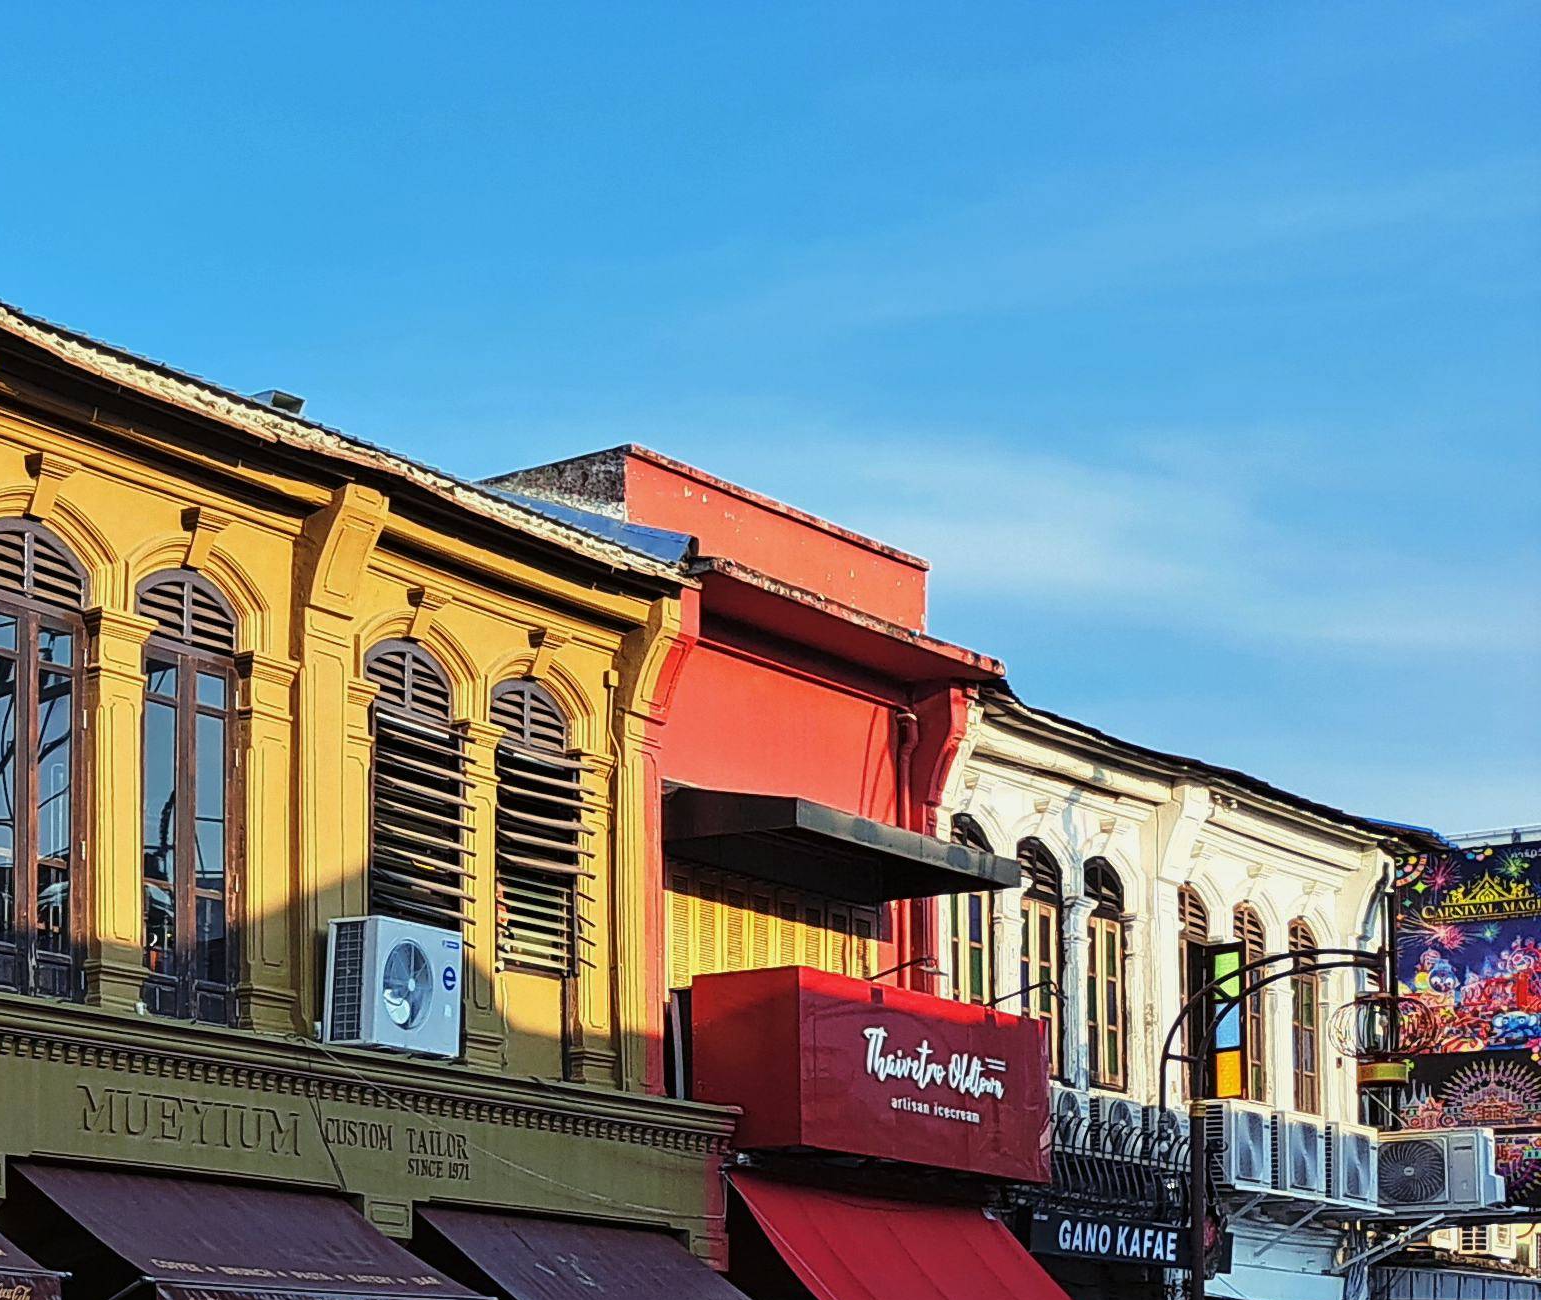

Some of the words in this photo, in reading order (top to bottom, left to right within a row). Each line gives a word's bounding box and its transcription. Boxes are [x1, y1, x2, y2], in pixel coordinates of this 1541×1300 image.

[1421, 903, 1498, 919] CARNIVAL
[891, 1097, 930, 1113] artisan
[933, 1101, 981, 1123] icecream
[325, 1116, 393, 1152] CUSTOM
[406, 1127, 469, 1160] TAILOR
[407, 1158, 443, 1178] SINCE
[448, 1162, 470, 1181] 1971
[1058, 1219, 1111, 1254] GANO
[1116, 1226, 1178, 1262] KAFAE
[150, 1258, 204, 1273] COFFEE
